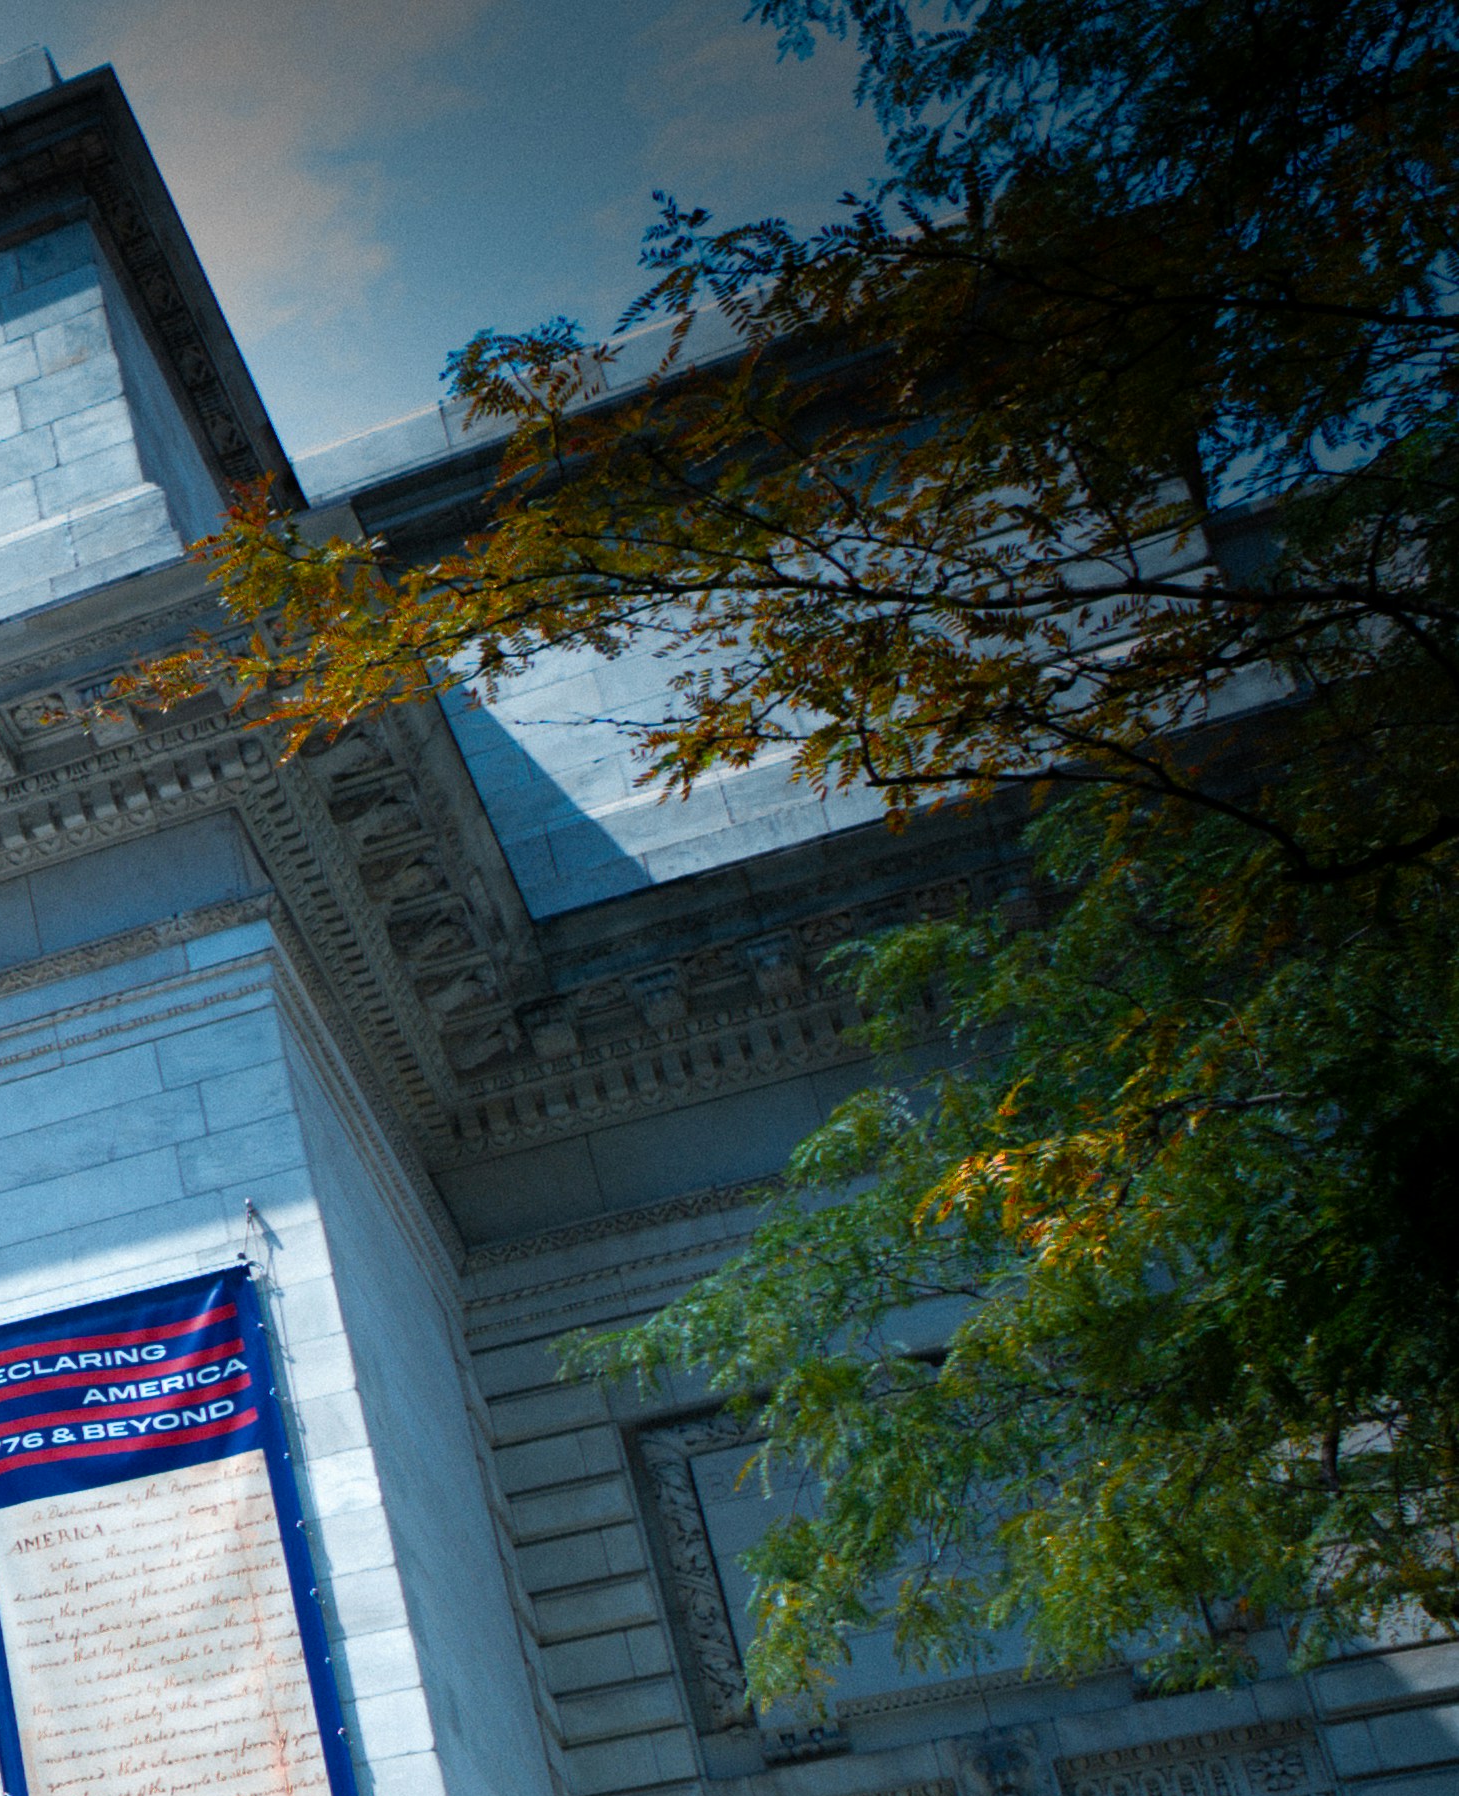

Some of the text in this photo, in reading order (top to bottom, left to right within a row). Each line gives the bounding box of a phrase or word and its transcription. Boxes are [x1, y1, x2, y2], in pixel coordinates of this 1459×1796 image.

[82, 1358, 248, 1405] AMERICA
[51, 1427, 77, 1444] &
[81, 1399, 235, 1441] BEYOND
[9, 1523, 104, 1554] AMERICA
